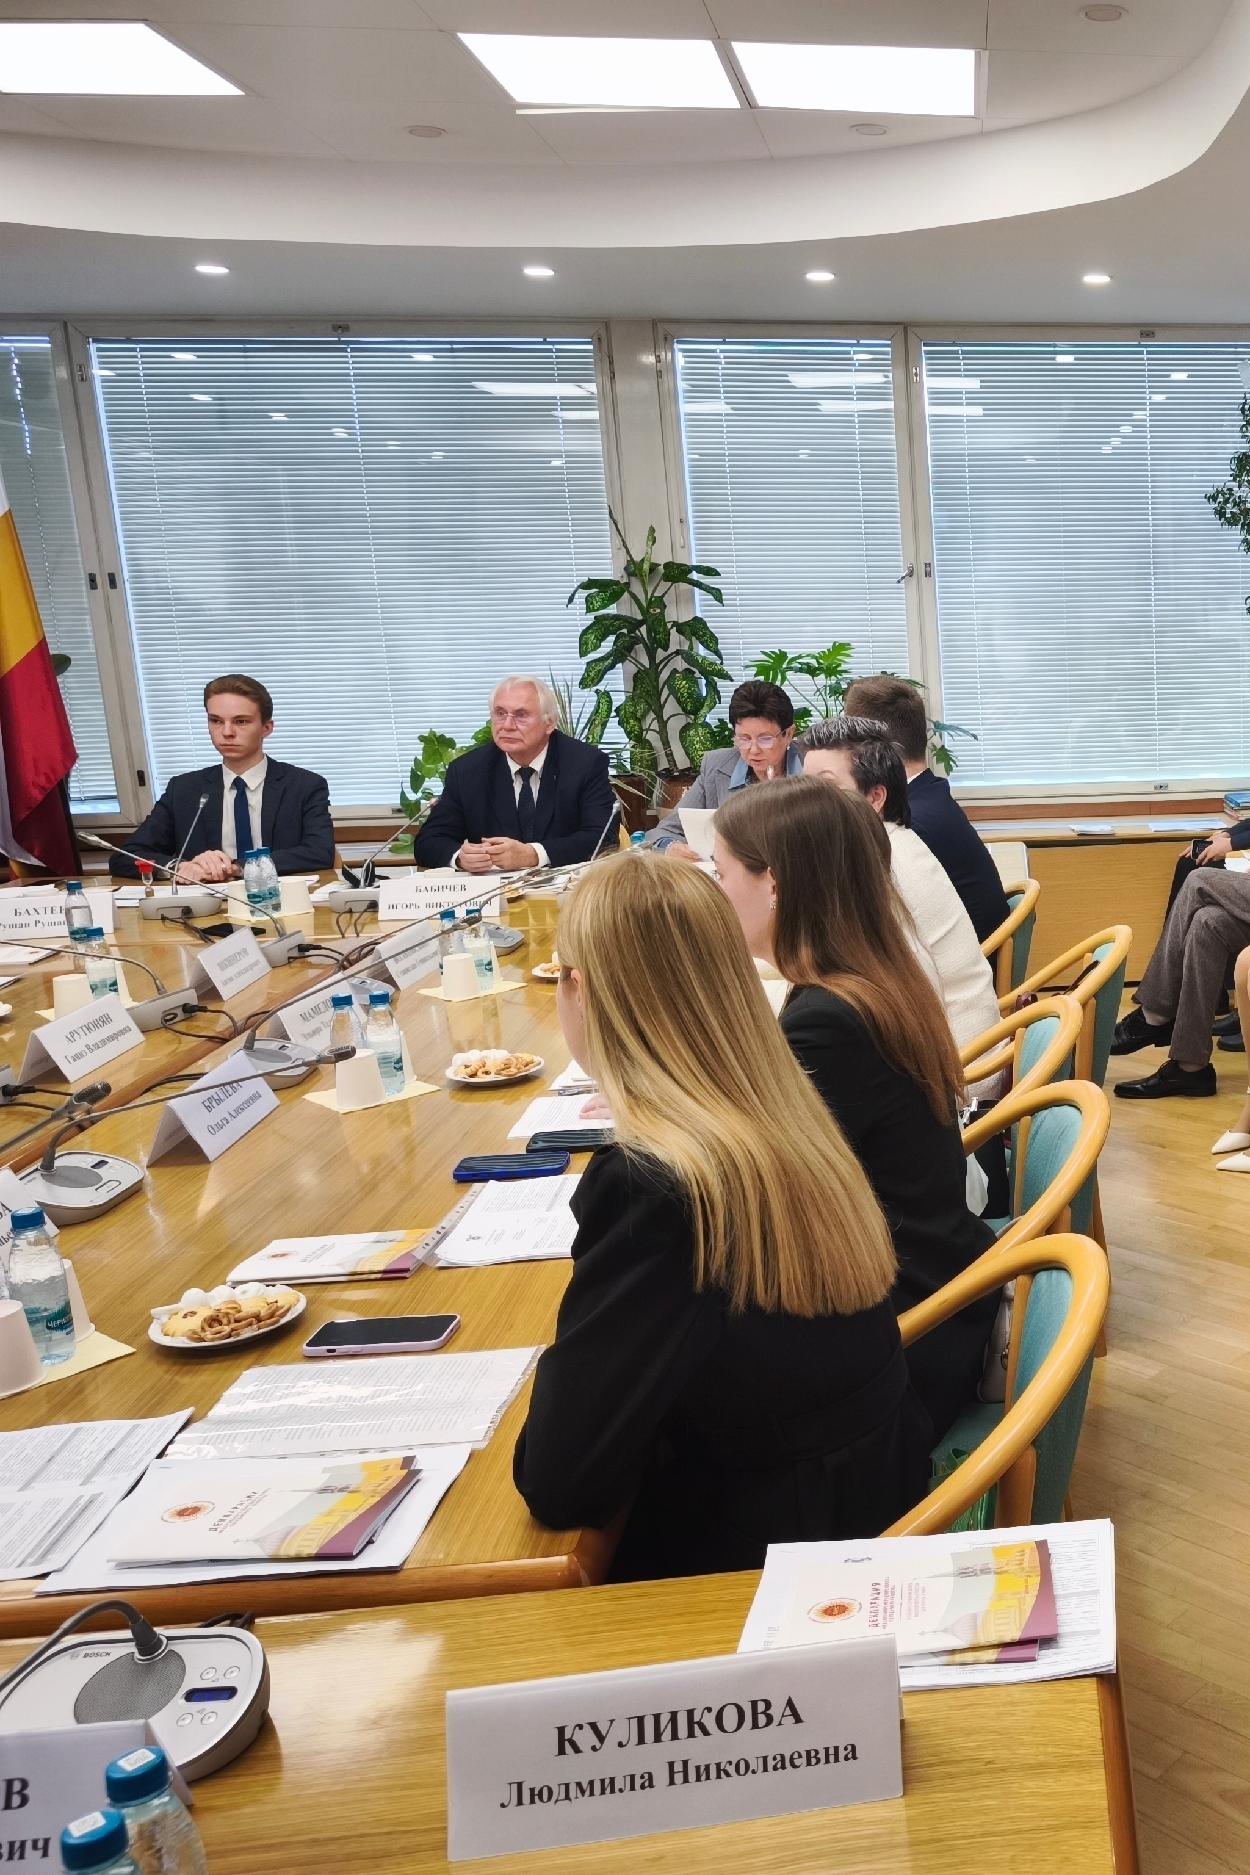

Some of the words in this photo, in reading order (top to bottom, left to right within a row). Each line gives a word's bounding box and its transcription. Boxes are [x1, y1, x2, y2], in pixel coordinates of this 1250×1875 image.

[415, 883, 467, 893] БАБИЧЕВ
[65, 1012, 113, 1045] АРУТЮНЯН
[207, 1117, 230, 1136] Ольга
[83, 1651, 111, 1659] BOSCH
[553, 1696, 804, 1757] КУЛИКОВА
[499, 1771, 655, 1809] Людмила
[666, 1742, 859, 1787] Николаевна
